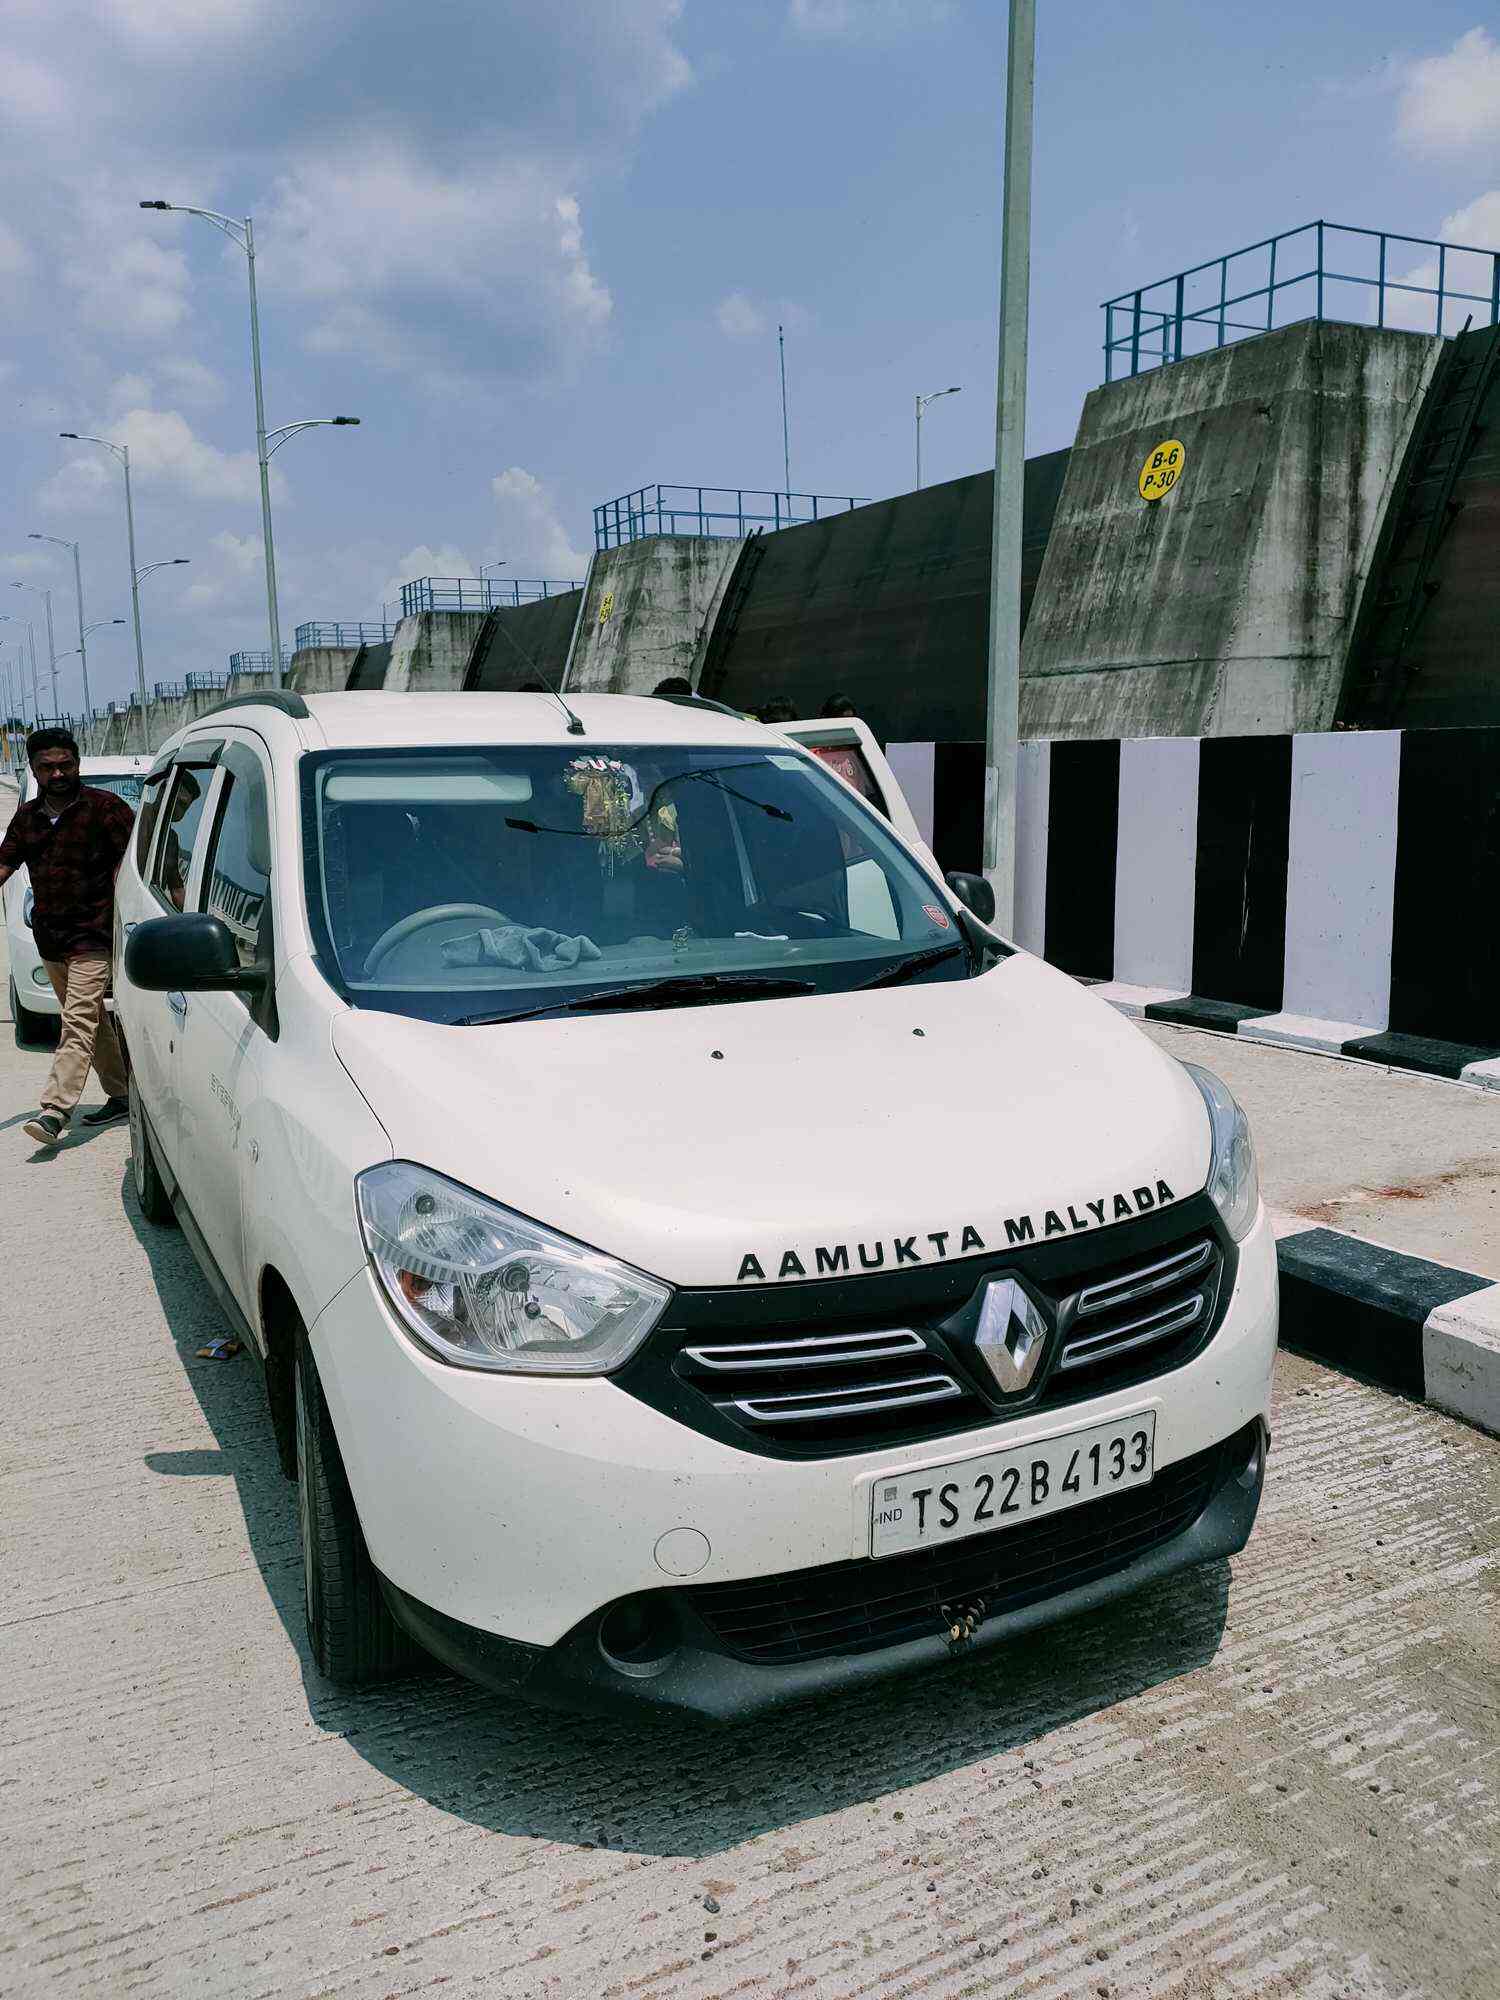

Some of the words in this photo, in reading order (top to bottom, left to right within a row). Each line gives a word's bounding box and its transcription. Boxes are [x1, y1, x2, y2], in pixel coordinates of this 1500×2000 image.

[1152, 447, 1179, 469] B-6
[1143, 470, 1176, 491] P-30
[736, 1225, 986, 1281] AAMUKTA
[1003, 1179, 1176, 1244] MALYADA
[879, 1508, 903, 1525] IND
